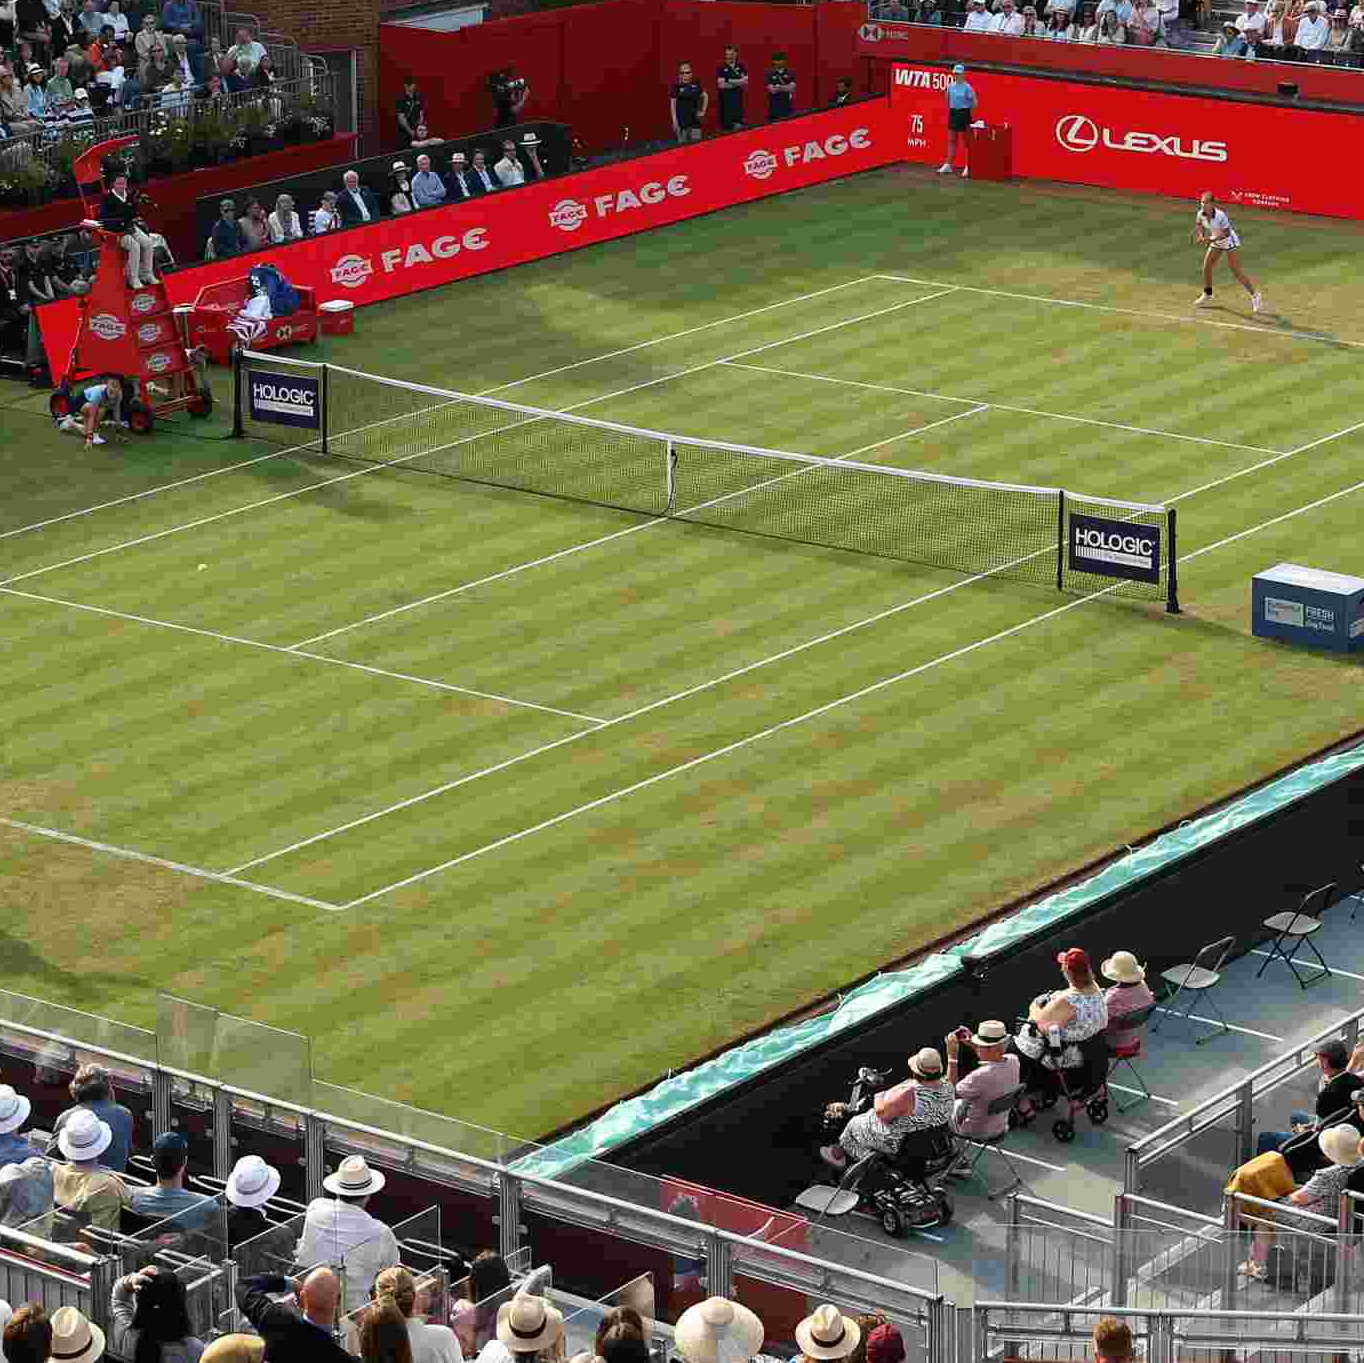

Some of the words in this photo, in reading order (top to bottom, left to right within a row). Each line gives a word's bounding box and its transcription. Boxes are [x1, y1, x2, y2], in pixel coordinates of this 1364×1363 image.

[894, 68, 931, 89] WTA
[911, 115, 924, 133] 75
[783, 128, 872, 167] FAGE
[1103, 128, 1228, 162] LEXUS
[594, 175, 692, 217] FAGE
[381, 228, 490, 273] FAGE
[253, 382, 315, 405] HOLOGIC
[1075, 527, 1153, 556] HOLOGIC
